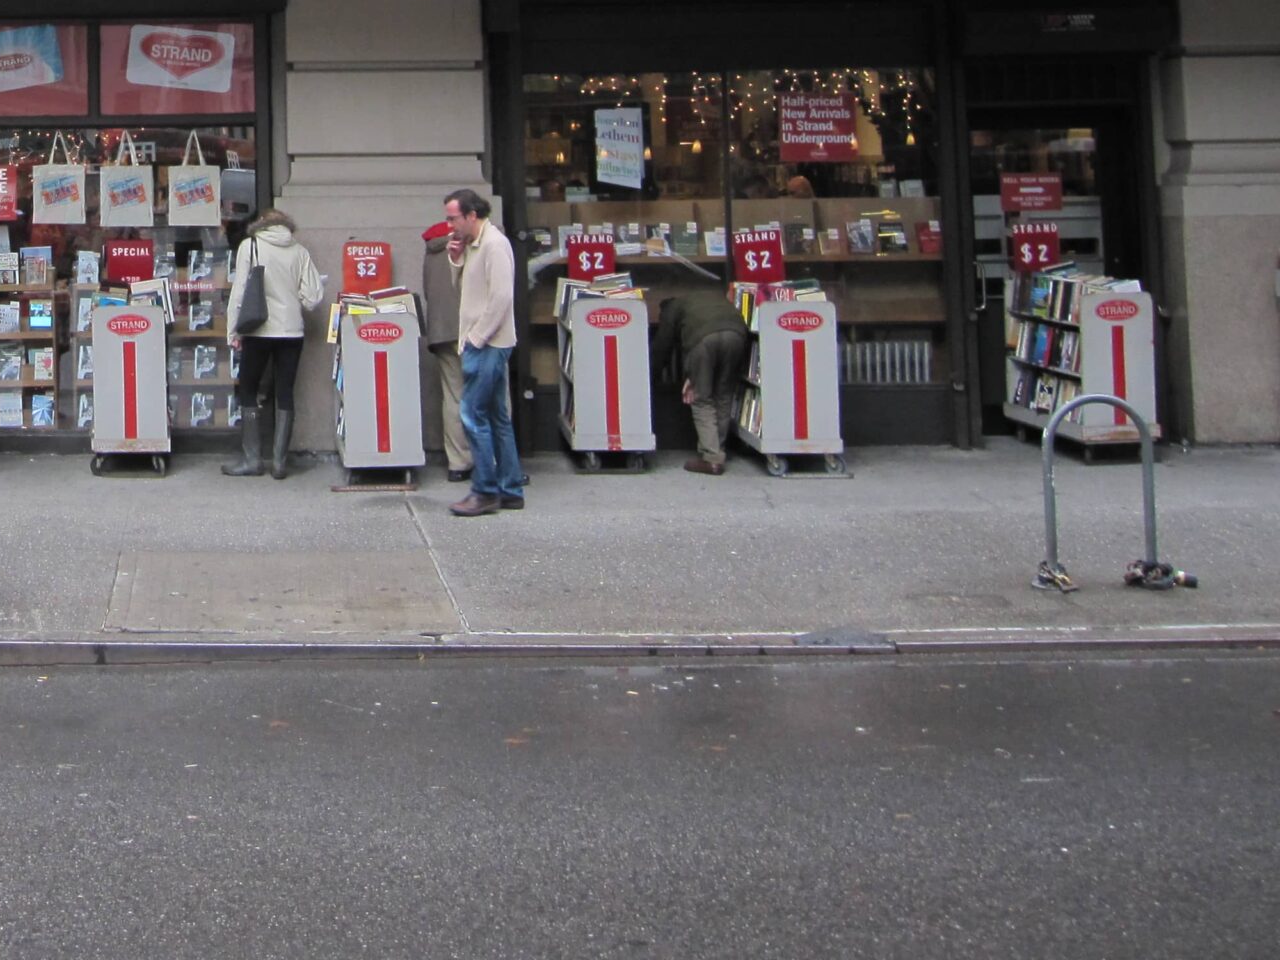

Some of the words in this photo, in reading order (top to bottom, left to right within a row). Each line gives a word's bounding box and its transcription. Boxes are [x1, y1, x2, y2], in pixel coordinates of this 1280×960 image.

[151, 44, 212, 62] STRAND
[782, 96, 843, 108] Half-priced
[782, 108, 806, 119] New
[810, 108, 850, 119] Arrivals
[782, 121, 793, 131] in
[796, 120, 833, 131] Strand
[782, 132, 855, 145] Underground
[1012, 223, 1057, 234] STRAND
[569, 234, 613, 244] STRAND
[735, 231, 776, 244] STRAND
[112, 247, 150, 256] SPECIAL
[347, 246, 385, 256] SPECIAL
[357, 261, 377, 278] $2
[1098, 305, 1136, 315] STRAND
[588, 314, 628, 323] STRAND
[780, 316, 819, 326] STRAND
[110, 320, 148, 330] STRAND
[360, 328, 400, 338] STRAND
